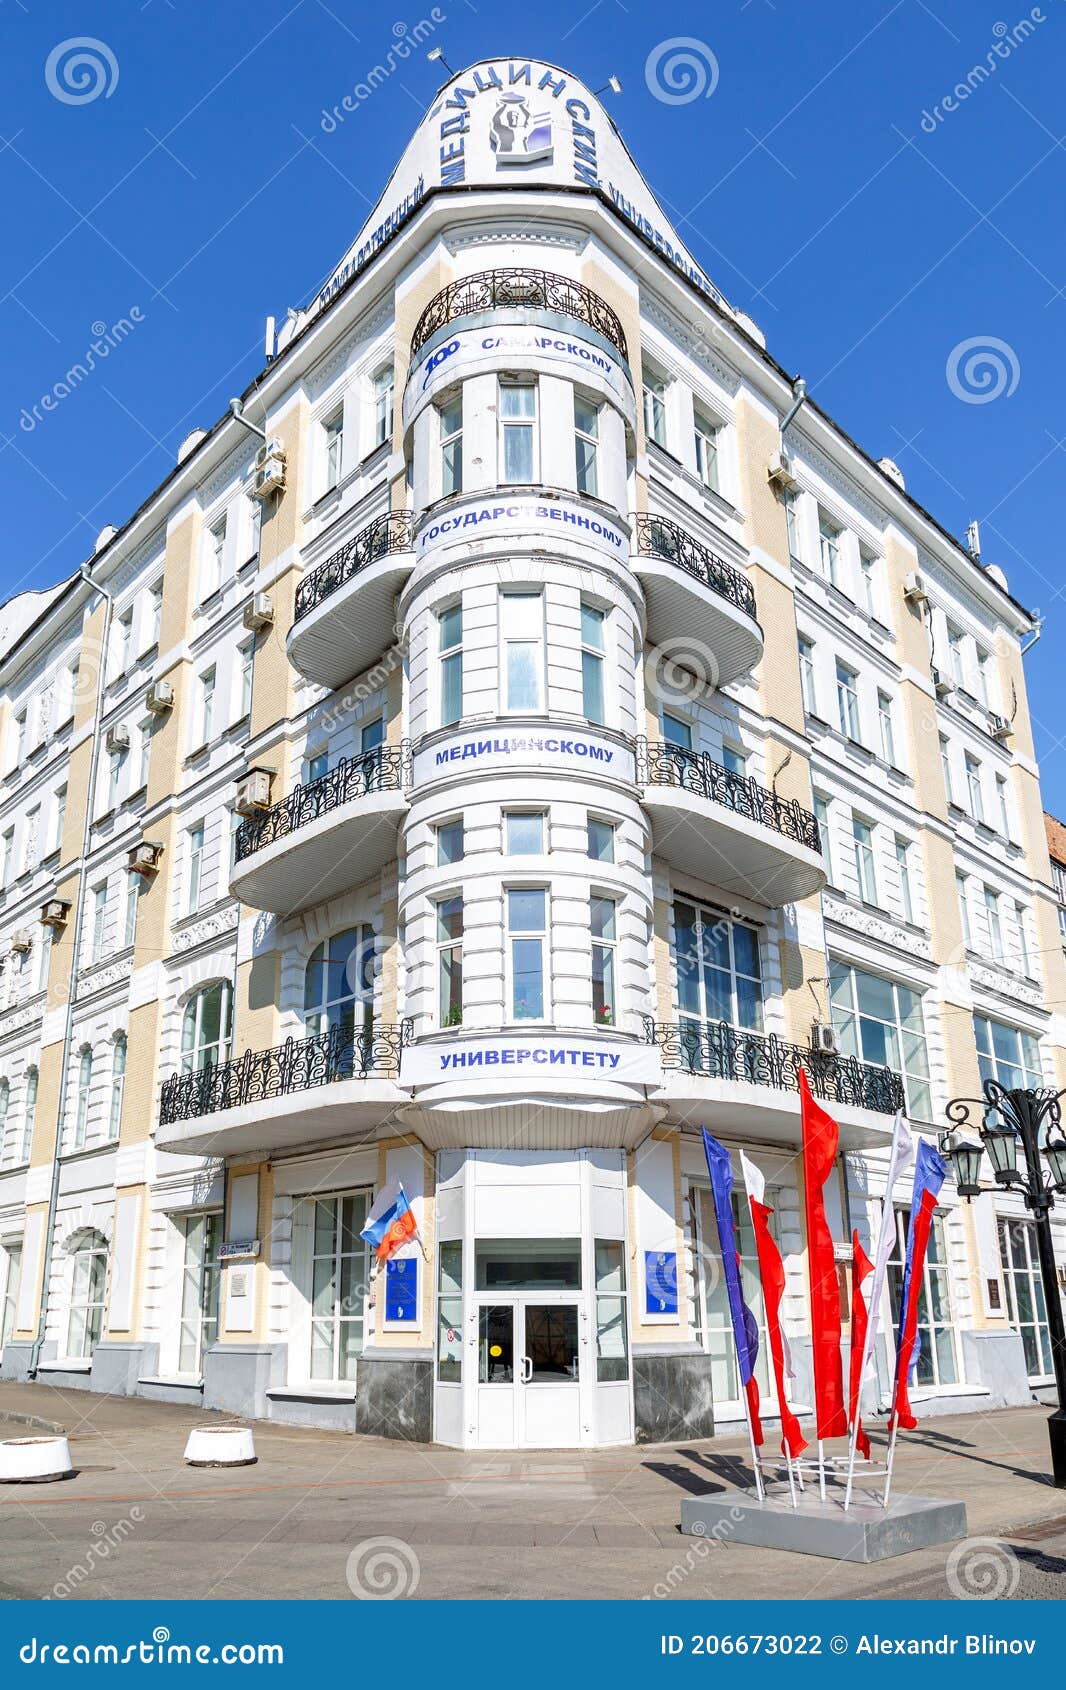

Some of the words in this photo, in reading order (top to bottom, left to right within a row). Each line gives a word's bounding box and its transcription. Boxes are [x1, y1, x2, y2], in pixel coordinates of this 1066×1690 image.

[482, 336, 612, 374] СААРСКОМУ
[422, 505, 622, 548] ГОСУДАРСВЕННОМУ
[440, 1048, 621, 1070] УНИВЕРСИТЕТУ
